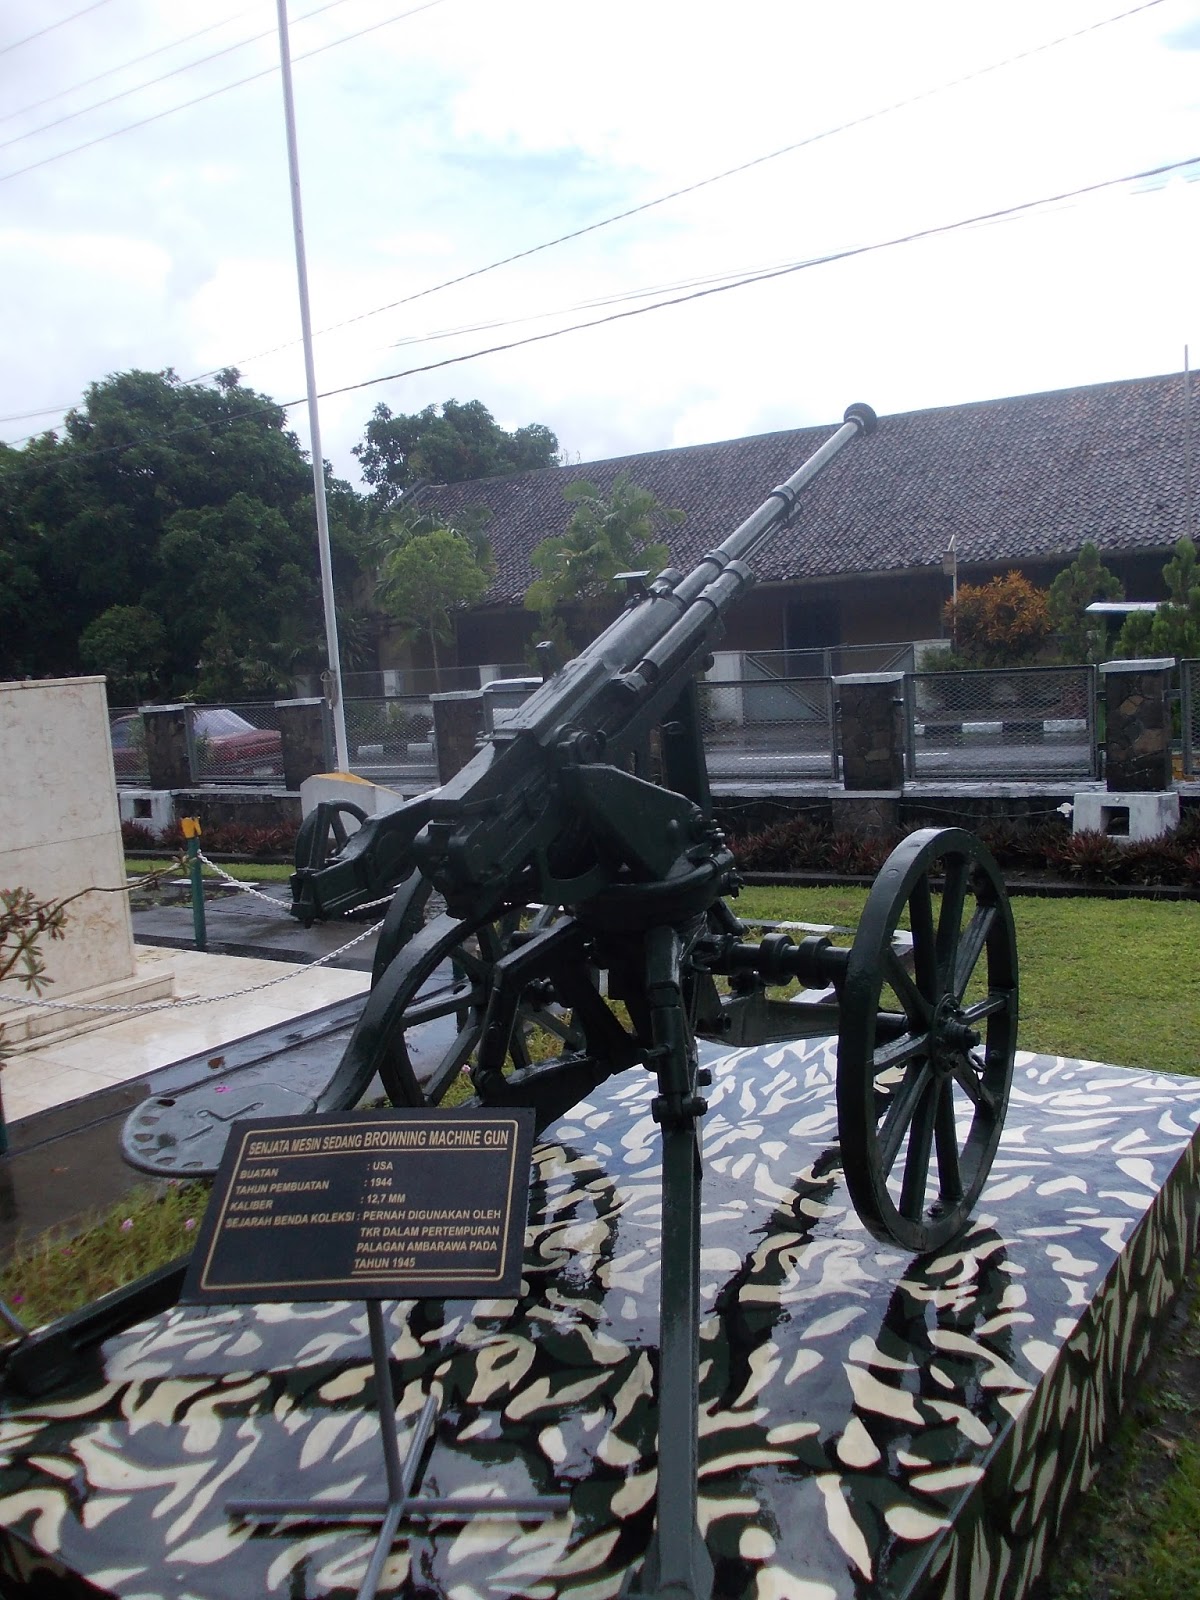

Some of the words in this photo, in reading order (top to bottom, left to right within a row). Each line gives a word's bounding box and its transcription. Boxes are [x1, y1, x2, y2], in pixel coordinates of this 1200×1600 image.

[248, 1140, 290, 1156] SENJATA
[290, 1137, 321, 1152] MESIN
[322, 1134, 363, 1150] SEDANG
[363, 1130, 426, 1148] BROWNING
[428, 1129, 481, 1146] MACHINE
[483, 1129, 509, 1146] GUN
[239, 1167, 280, 1180] BUATAN
[372, 1160, 394, 1171] USA
[235, 1184, 269, 1196] TAHUN
[268, 1180, 331, 1193] PEMBUATAN
[370, 1177, 393, 1187] 1944
[229, 1199, 275, 1212] KALIBER
[387, 1193, 407, 1204] MM
[225, 1215, 273, 1229] SEJARAH
[273, 1213, 310, 1227] BENDA
[309, 1210, 356, 1224] KOLEKSI
[362, 1210, 406, 1221] PERNAH
[407, 1209, 471, 1220] DIGUNAKAN
[472, 1209, 502, 1220] OLEH
[360, 1226, 381, 1238] TKR
[382, 1226, 420, 1237] DALAM
[421, 1225, 500, 1237] PERTEMPURAN
[356, 1242, 405, 1254] PALAGAN
[406, 1241, 468, 1252] AMBARAWA
[469, 1240, 498, 1251] PADA
[354, 1258, 391, 1270] TAHUN
[391, 1257, 416, 1269] 1945
